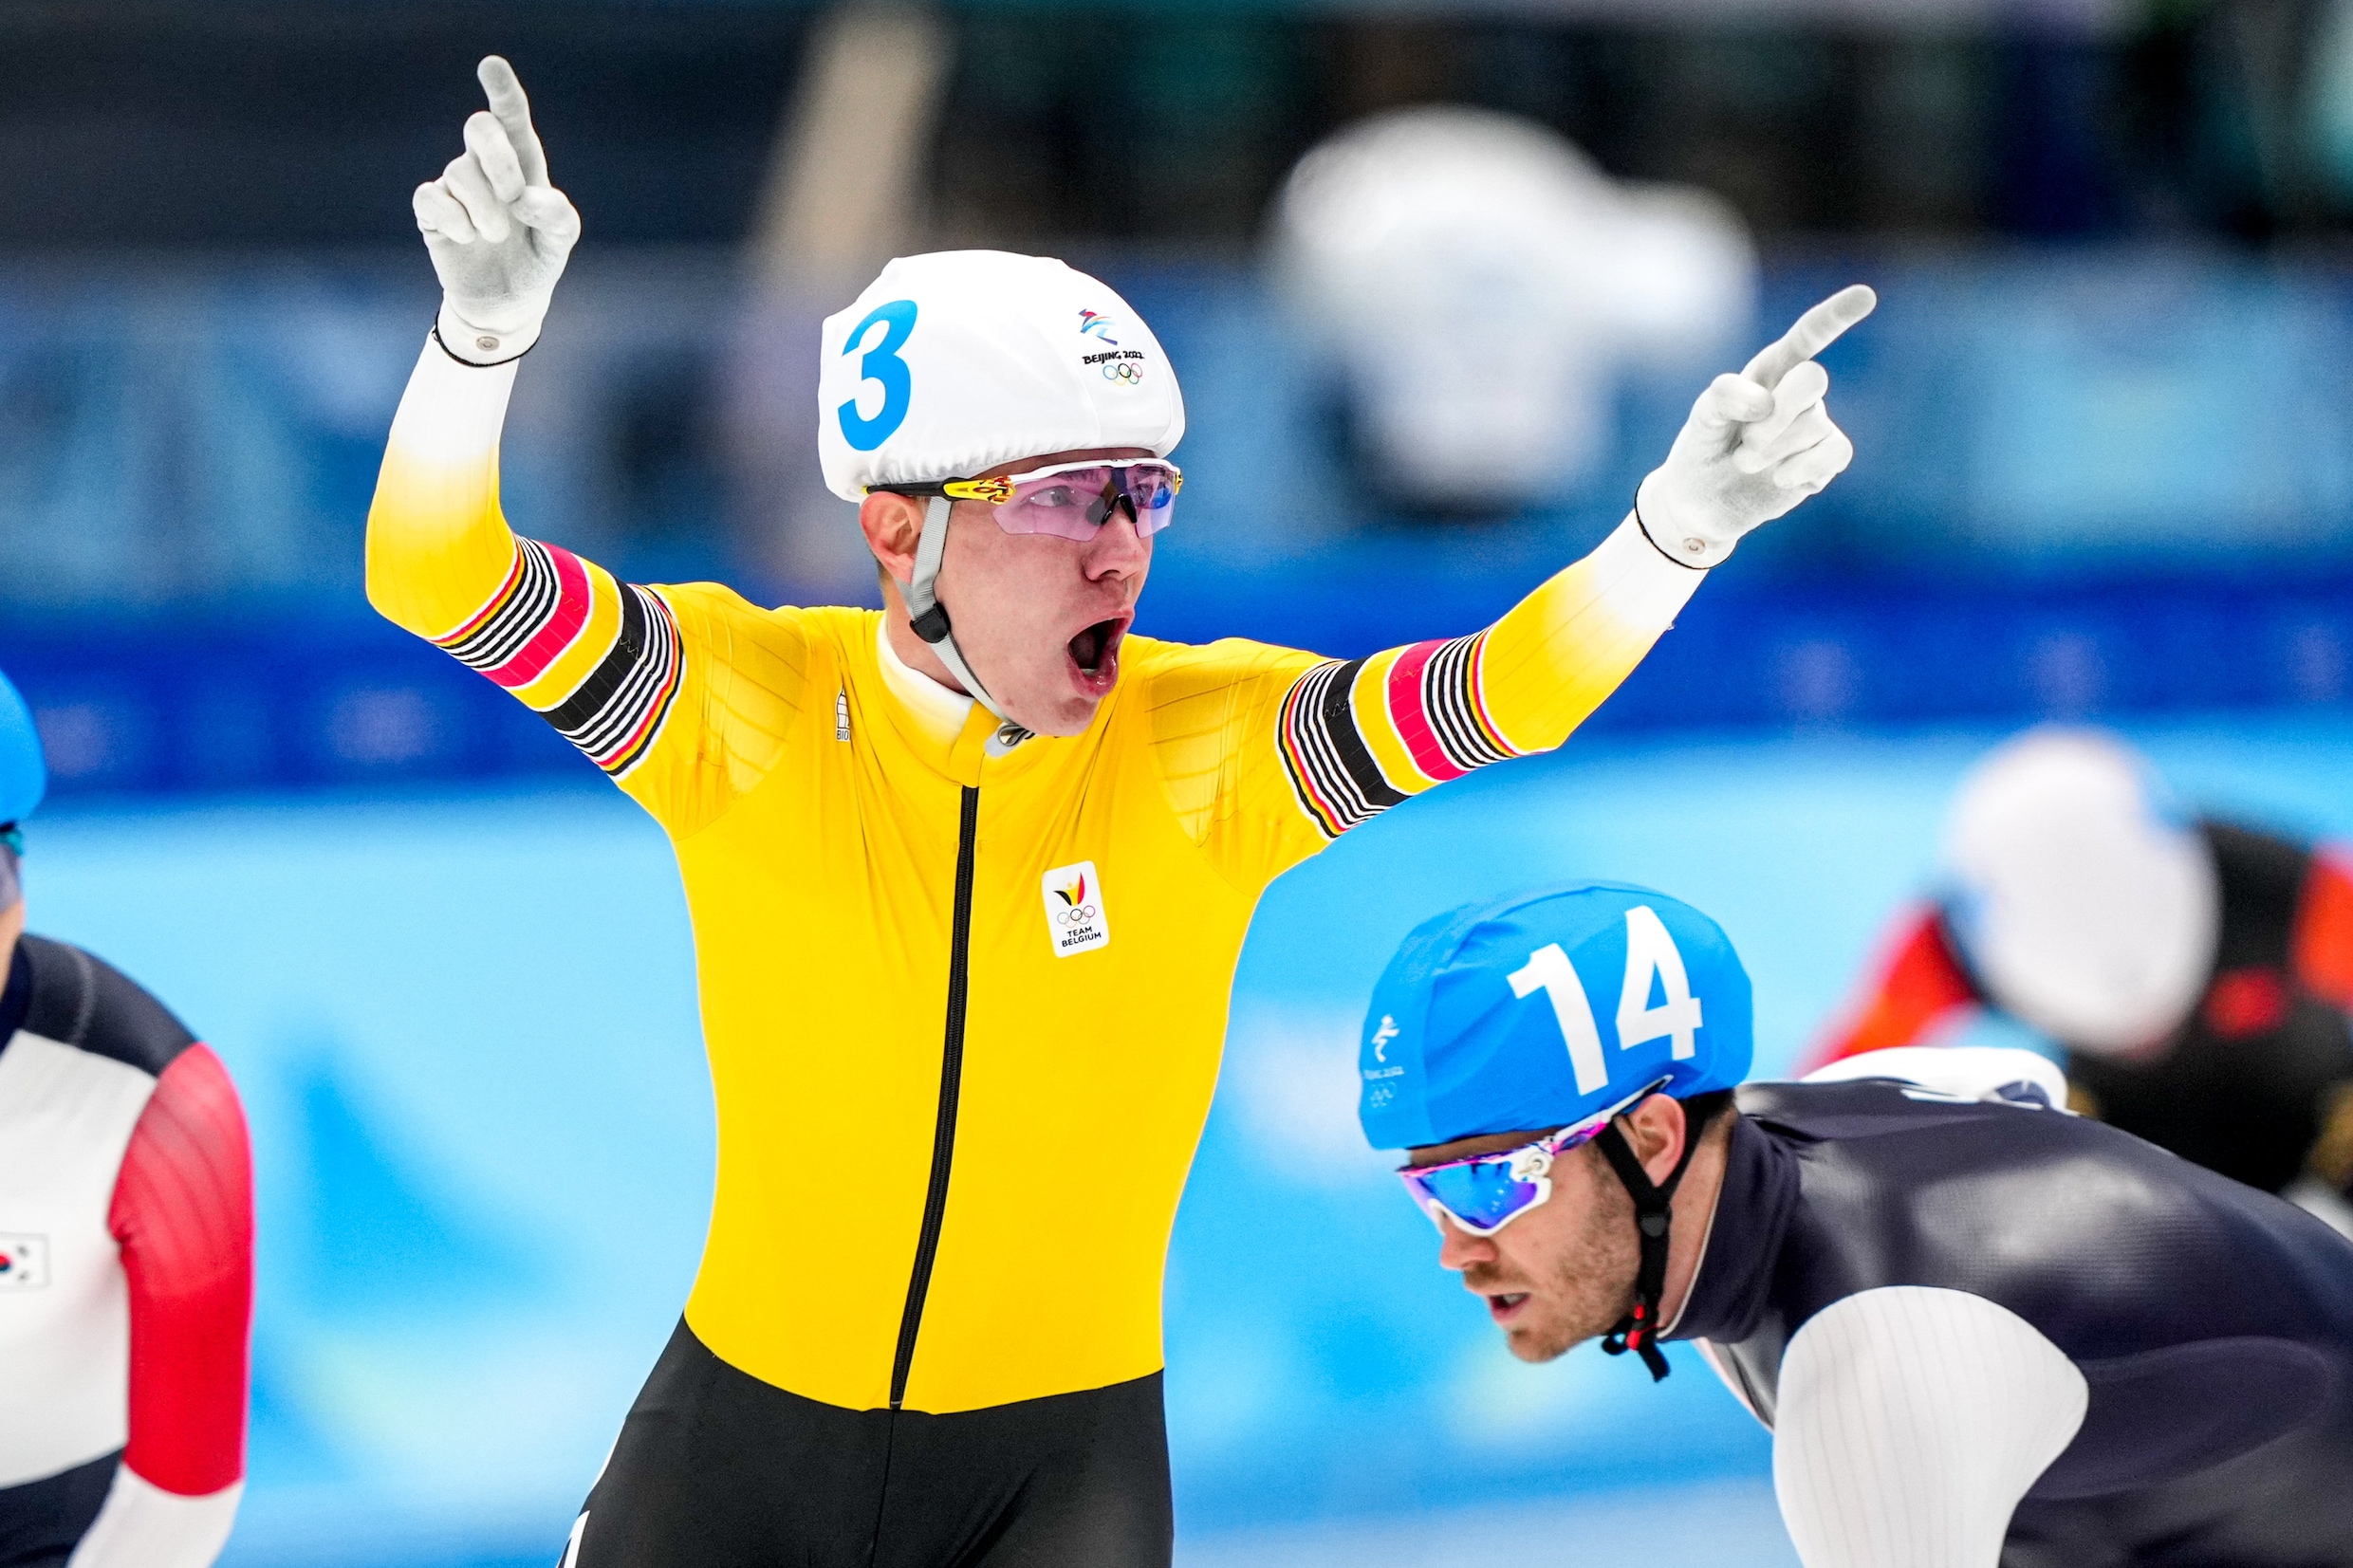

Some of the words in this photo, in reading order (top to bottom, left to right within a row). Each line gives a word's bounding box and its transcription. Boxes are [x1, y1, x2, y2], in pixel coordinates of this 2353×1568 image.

[1082, 351, 1121, 364] BEIJING
[1122, 351, 1145, 360] 2022
[838, 300, 917, 452] 3
[1067, 926, 1093, 937] TEAM
[1062, 932, 1102, 948] BELGIUM
[1506, 905, 1704, 1097] 14
